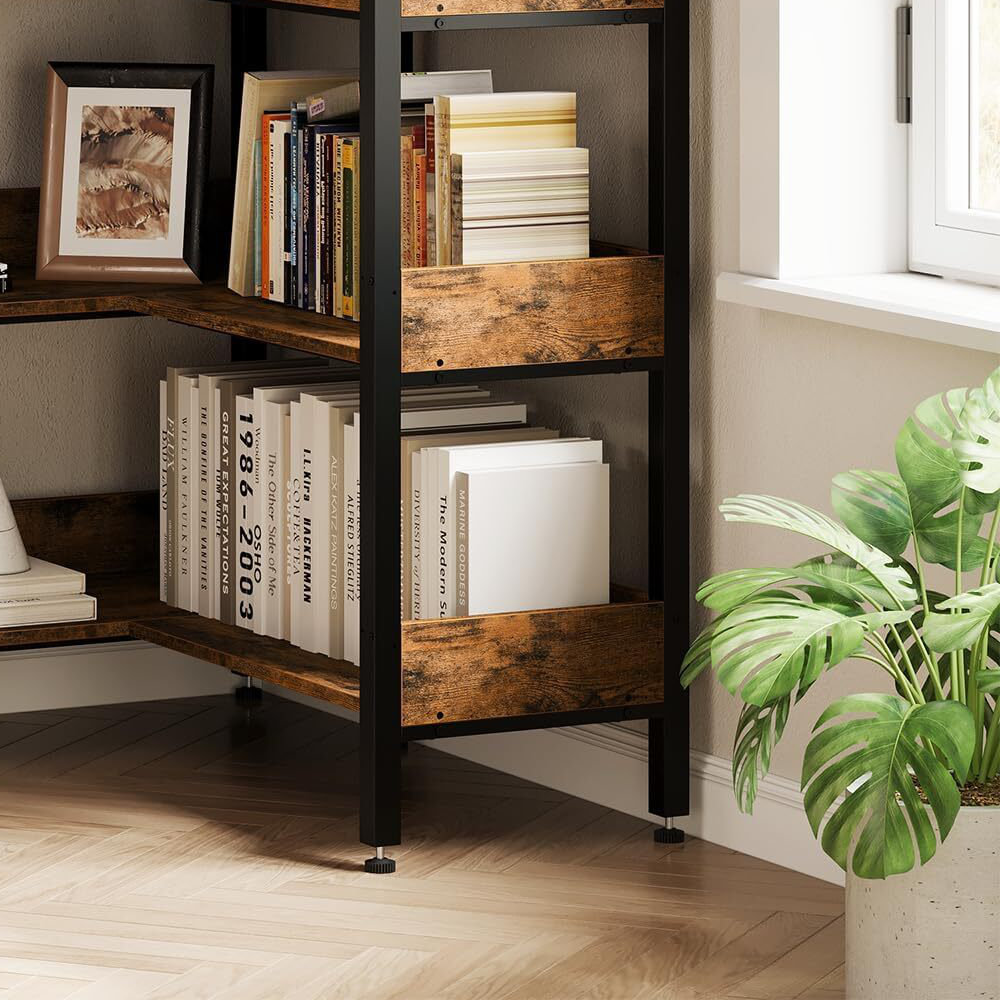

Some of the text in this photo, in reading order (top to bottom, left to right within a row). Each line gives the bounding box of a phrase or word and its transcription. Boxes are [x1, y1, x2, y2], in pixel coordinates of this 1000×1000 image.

[201, 490, 207, 503] OF
[269, 558, 276, 574] of
[269, 578, 276, 596] Me
